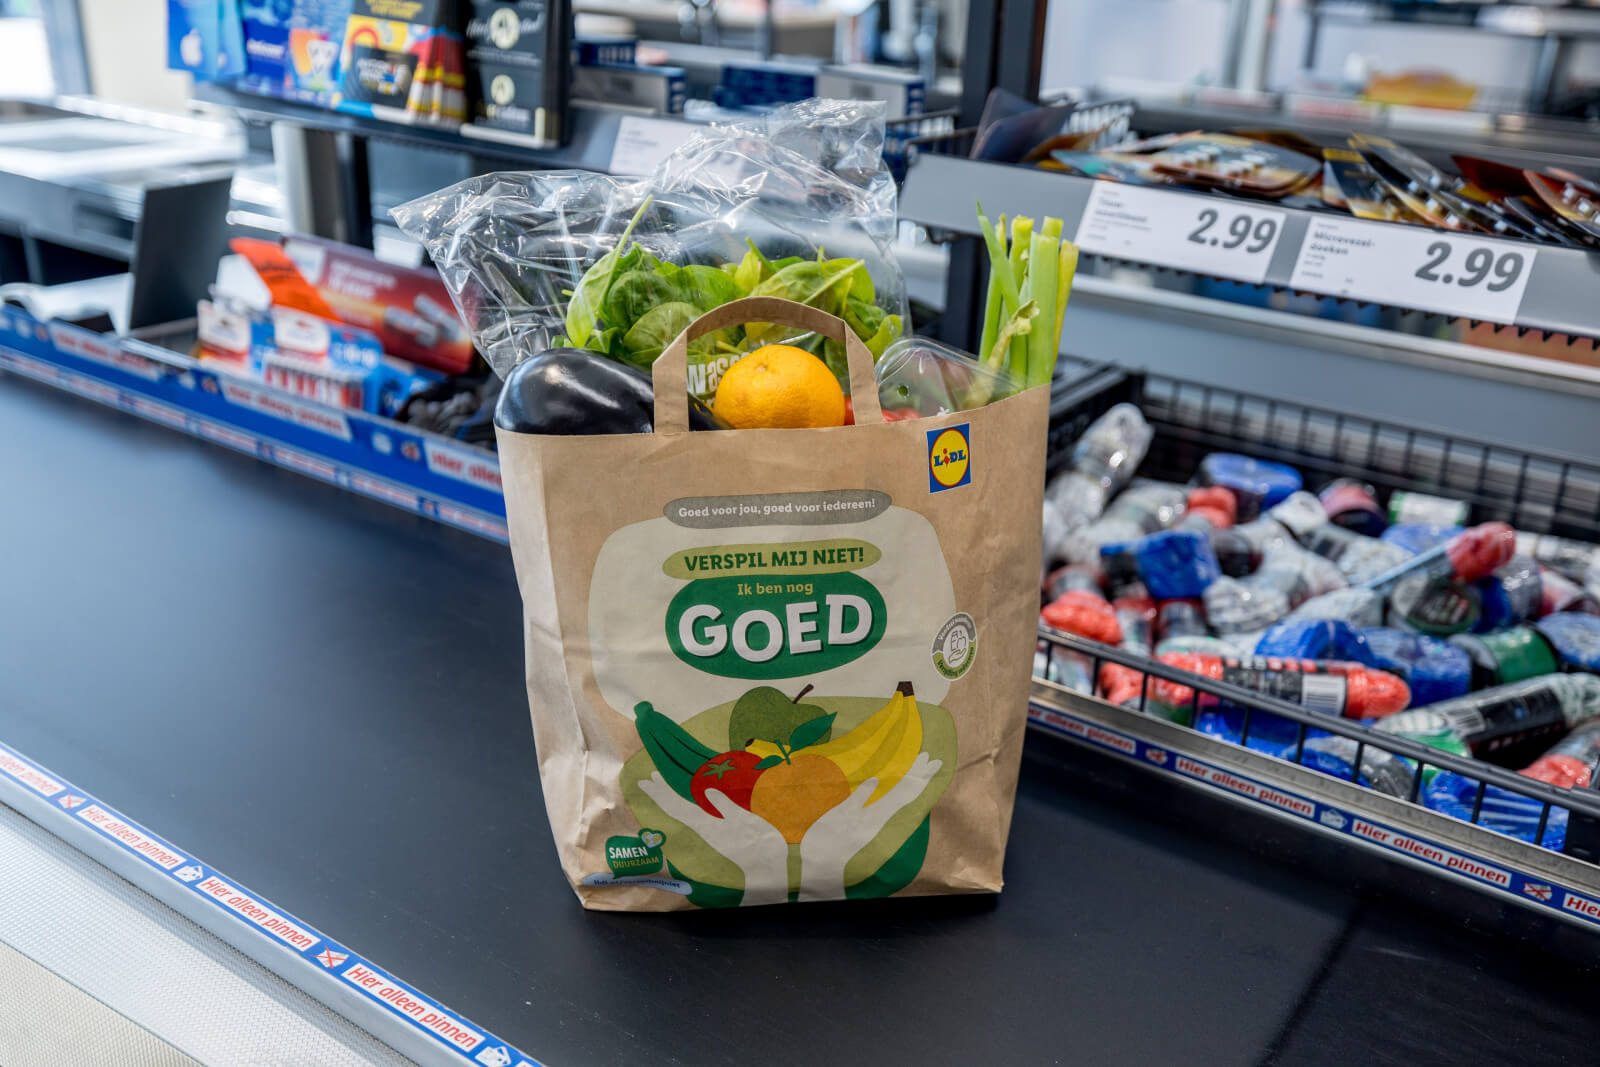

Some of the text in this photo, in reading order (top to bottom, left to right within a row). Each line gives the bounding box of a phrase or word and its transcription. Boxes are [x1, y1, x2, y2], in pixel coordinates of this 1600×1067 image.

[1187, 208, 1277, 254] 2.99
[1414, 240, 1524, 292] 2.99
[933, 447, 966, 468] LIDL
[679, 498, 876, 518] Goed voor jou, goed voor iedereen!
[684, 547, 864, 571] VERSPIL MIJ NIET!
[737, 582, 813, 596] Ik ben nog
[678, 593, 873, 664] GOED
[1087, 728, 1133, 752] pinnen
[1178, 759, 1312, 815] Hier alleen pinnen
[80, 806, 178, 866] Hier alleen pinnen
[609, 846, 649, 859] SAMEN
[1355, 821, 1507, 884] Hier alleen pinnen
[201, 879, 313, 948] Hier alleen pinnen
[347, 967, 477, 1048] Hier alleen pinnen
